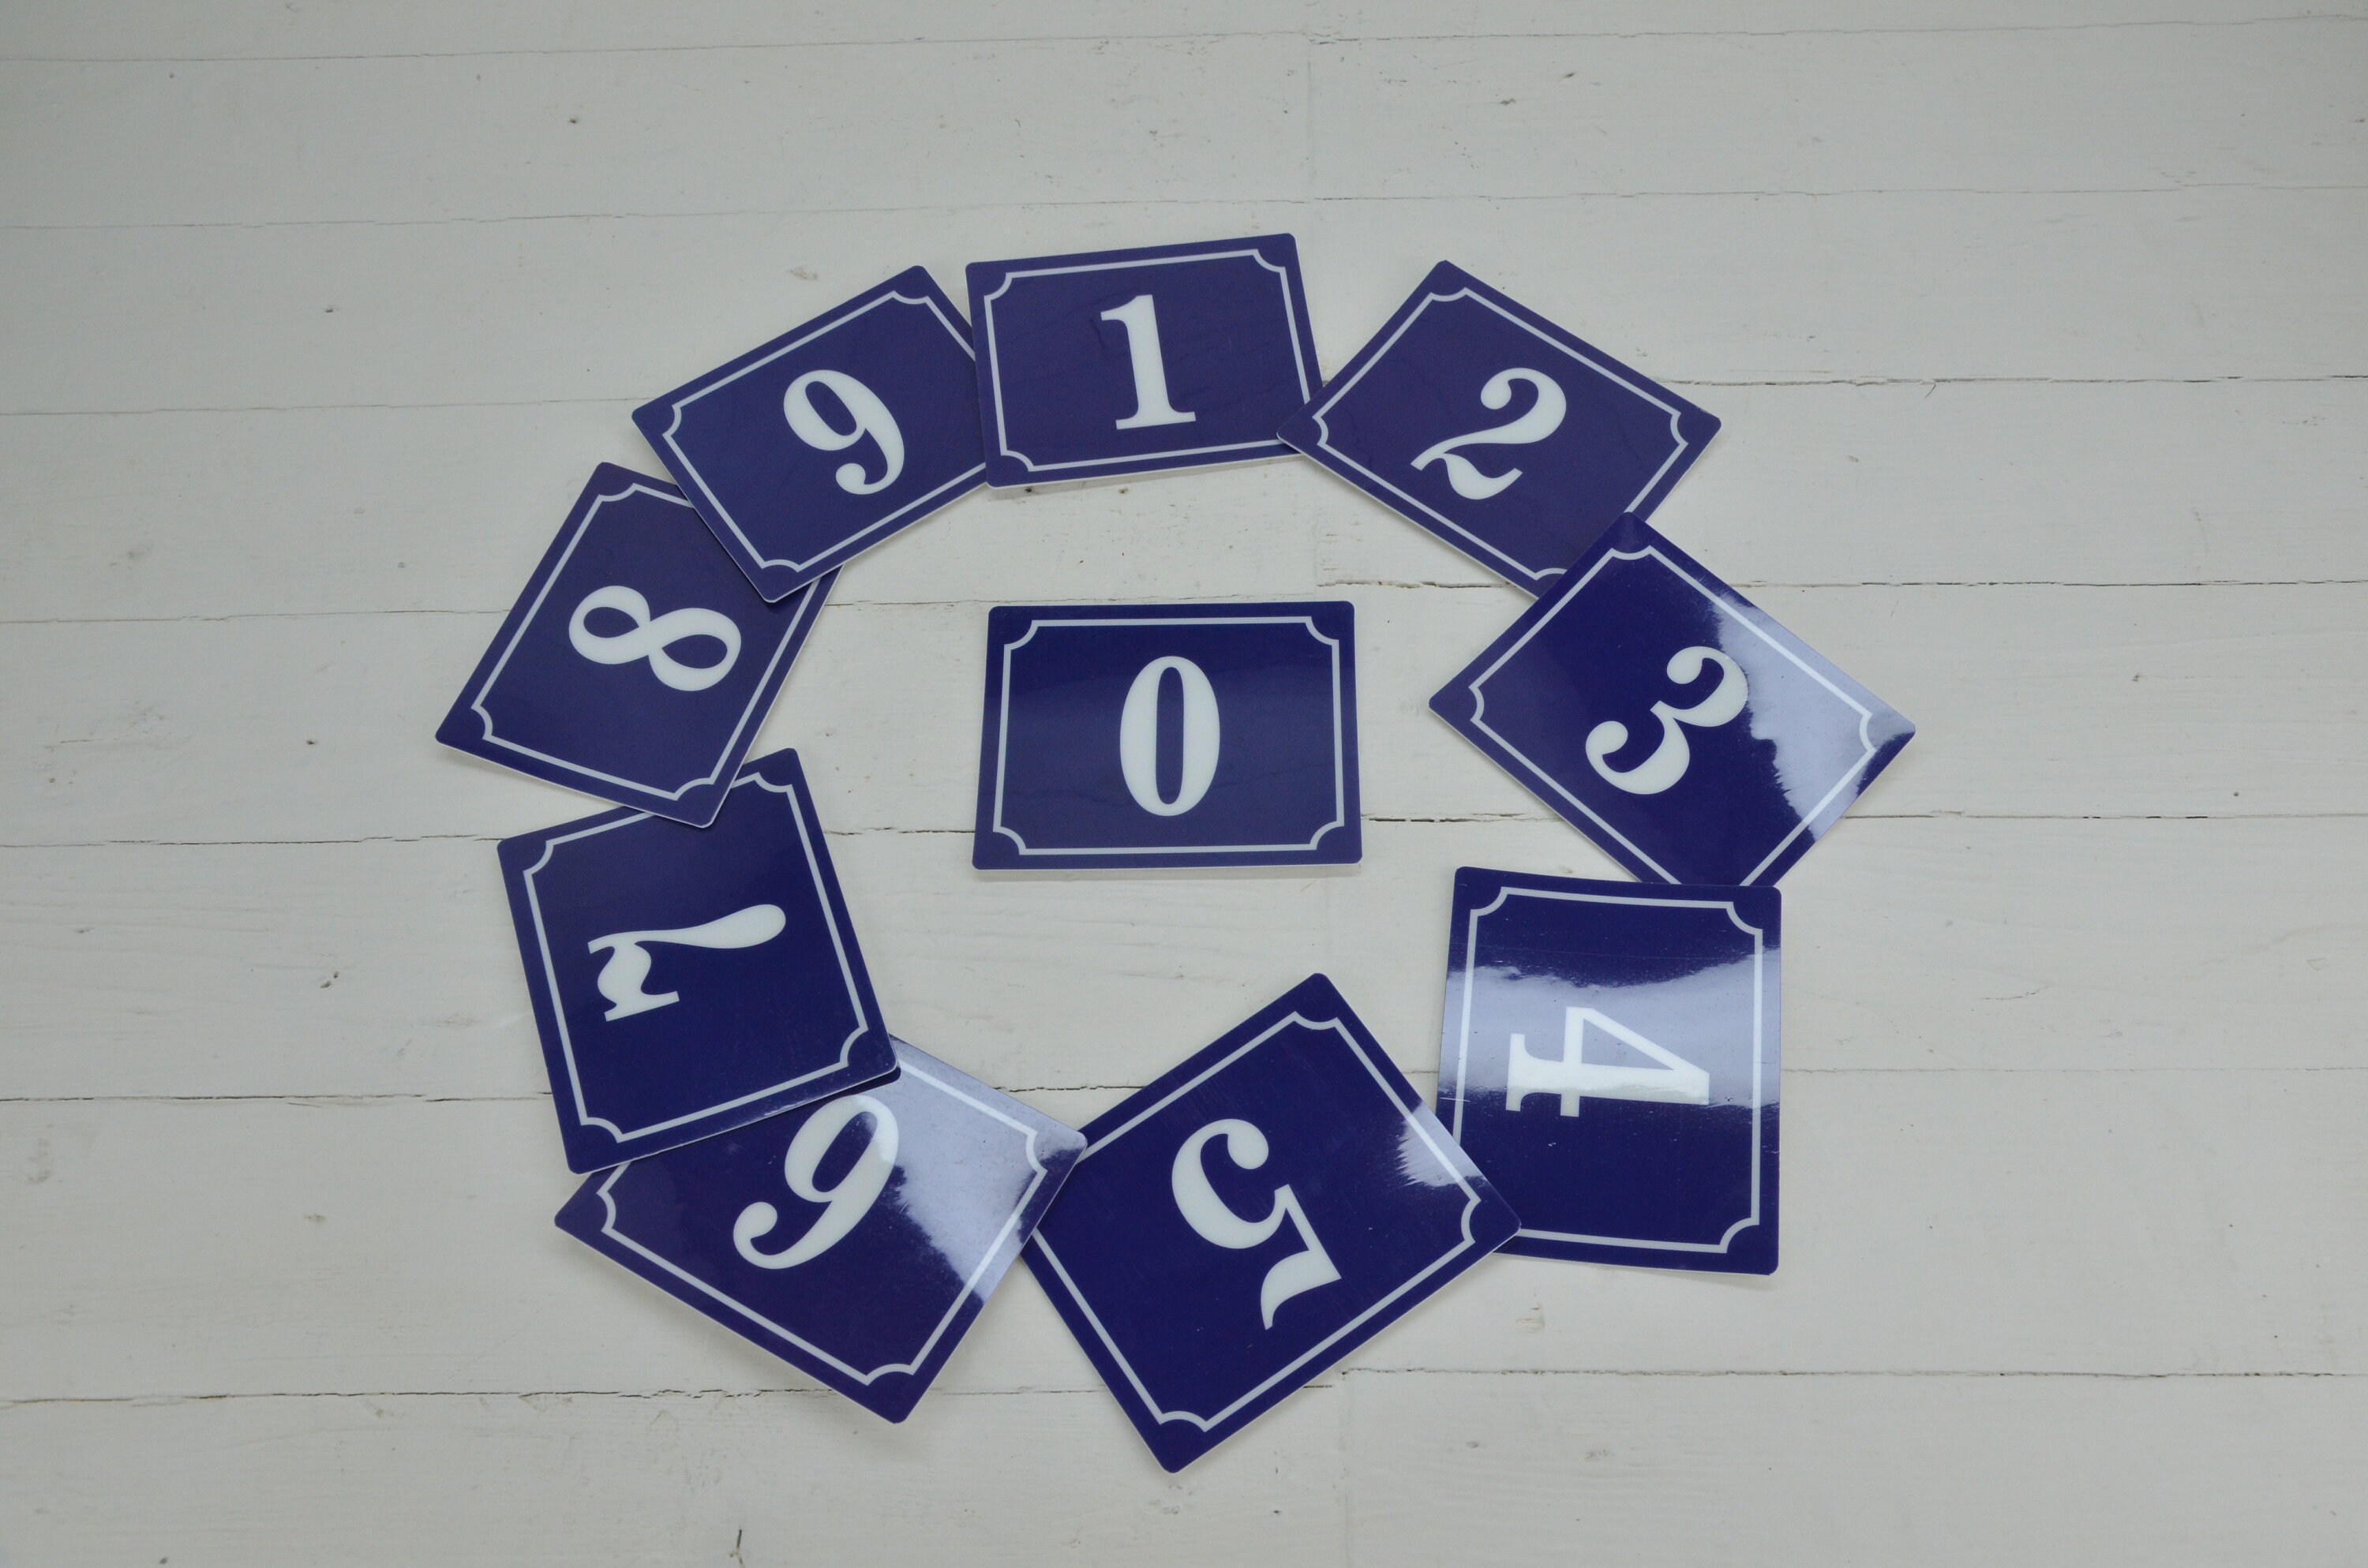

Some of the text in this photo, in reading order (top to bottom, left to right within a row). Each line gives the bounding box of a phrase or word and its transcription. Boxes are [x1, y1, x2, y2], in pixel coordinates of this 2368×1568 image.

[1101, 295, 1196, 429] 1
[784, 370, 904, 494] 9
[1411, 368, 1566, 500] 2
[569, 586, 741, 691] 8
[1120, 657, 1220, 816] 0
[1586, 646, 1749, 795] 3
[588, 904, 785, 1021] 7
[1505, 1006, 1710, 1117] 4
[1172, 1119, 1341, 1330] 5
